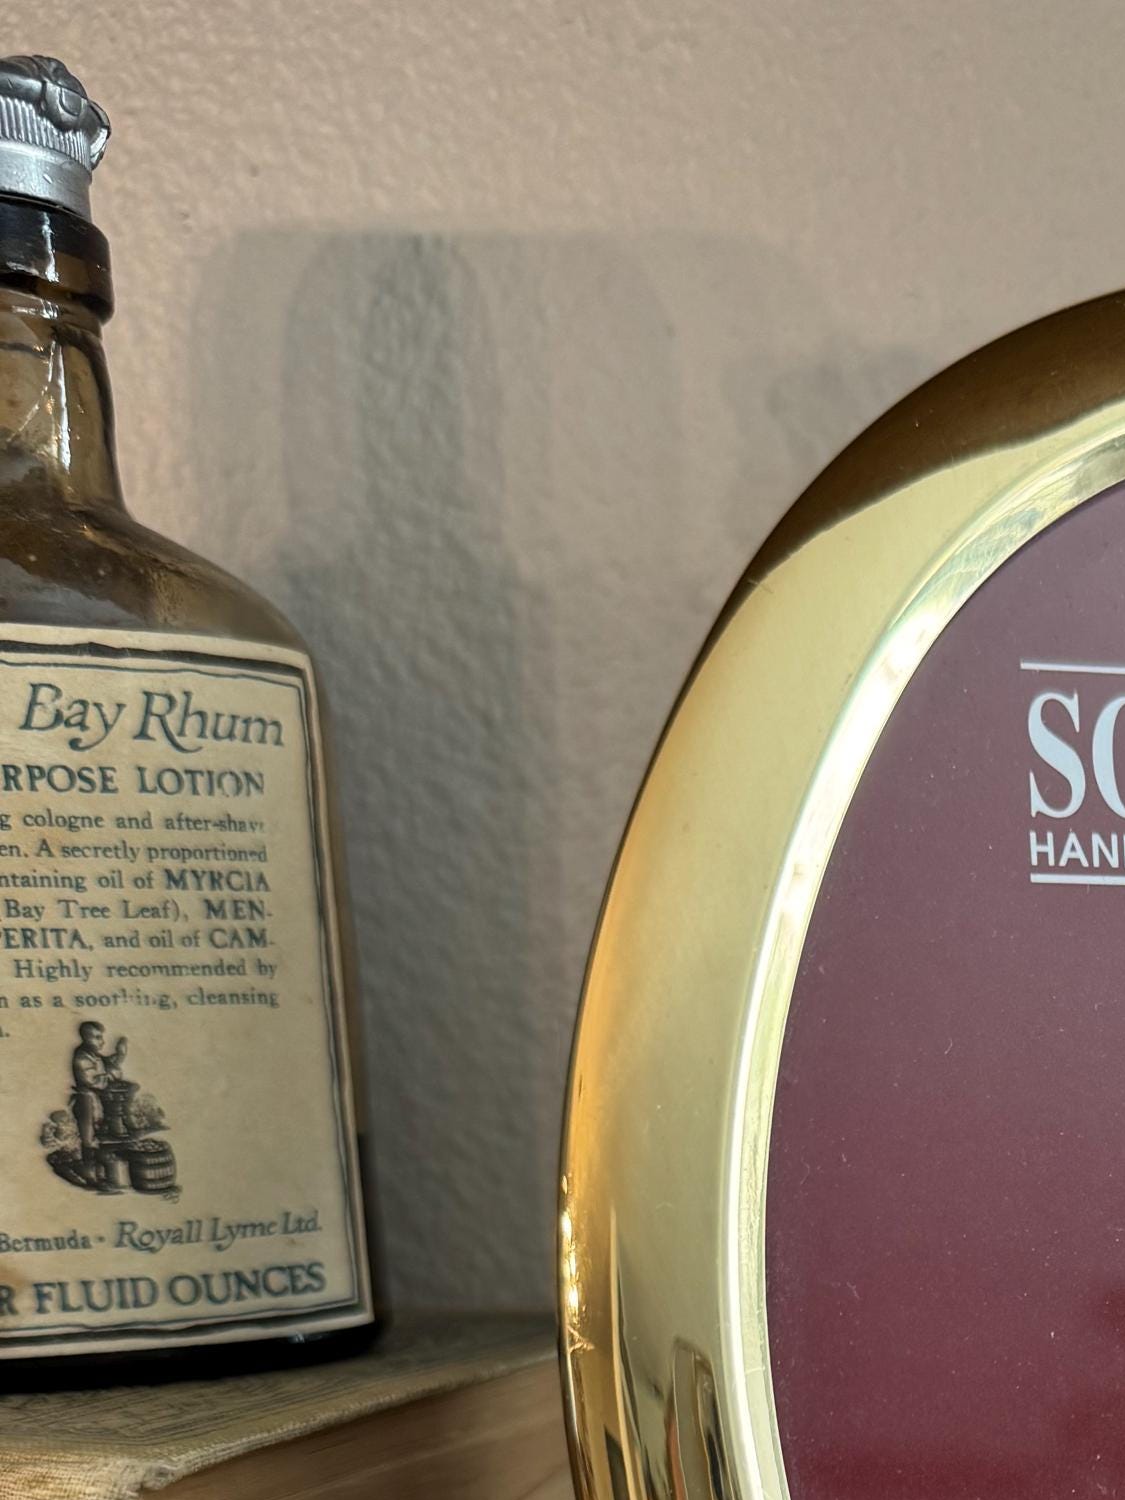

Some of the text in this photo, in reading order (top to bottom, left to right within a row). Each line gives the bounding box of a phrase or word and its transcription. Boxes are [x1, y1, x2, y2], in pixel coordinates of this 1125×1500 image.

[18, 681, 284, 754] Bay Rhum
[136, 765, 265, 797] LOTION
[23, 807, 105, 832] cologne
[116, 810, 153, 830] and
[36, 838, 55, 858] A
[61, 839, 138, 863] secretly
[146, 841, 268, 863] proportioned
[98, 869, 124, 889] oil
[133, 870, 154, 889] of
[164, 867, 271, 892] MYRCIA
[57, 899, 110, 919] Tree
[121, 899, 189, 922] Leaf),
[204, 898, 273, 921] MEN-
[0, 927, 276, 951] ERITA, and oil of CAM-
[13, 957, 278, 983] Highly recommended by
[20, 995, 42, 1008] as
[52, 995, 64, 1008] a
[187, 985, 280, 1009] cleansing
[0, 1209, 323, 1254] Bermuda Royall Lyme Ltd.
[33, 1276, 159, 1314] FLUID
[168, 1261, 327, 1306] OUNCES
